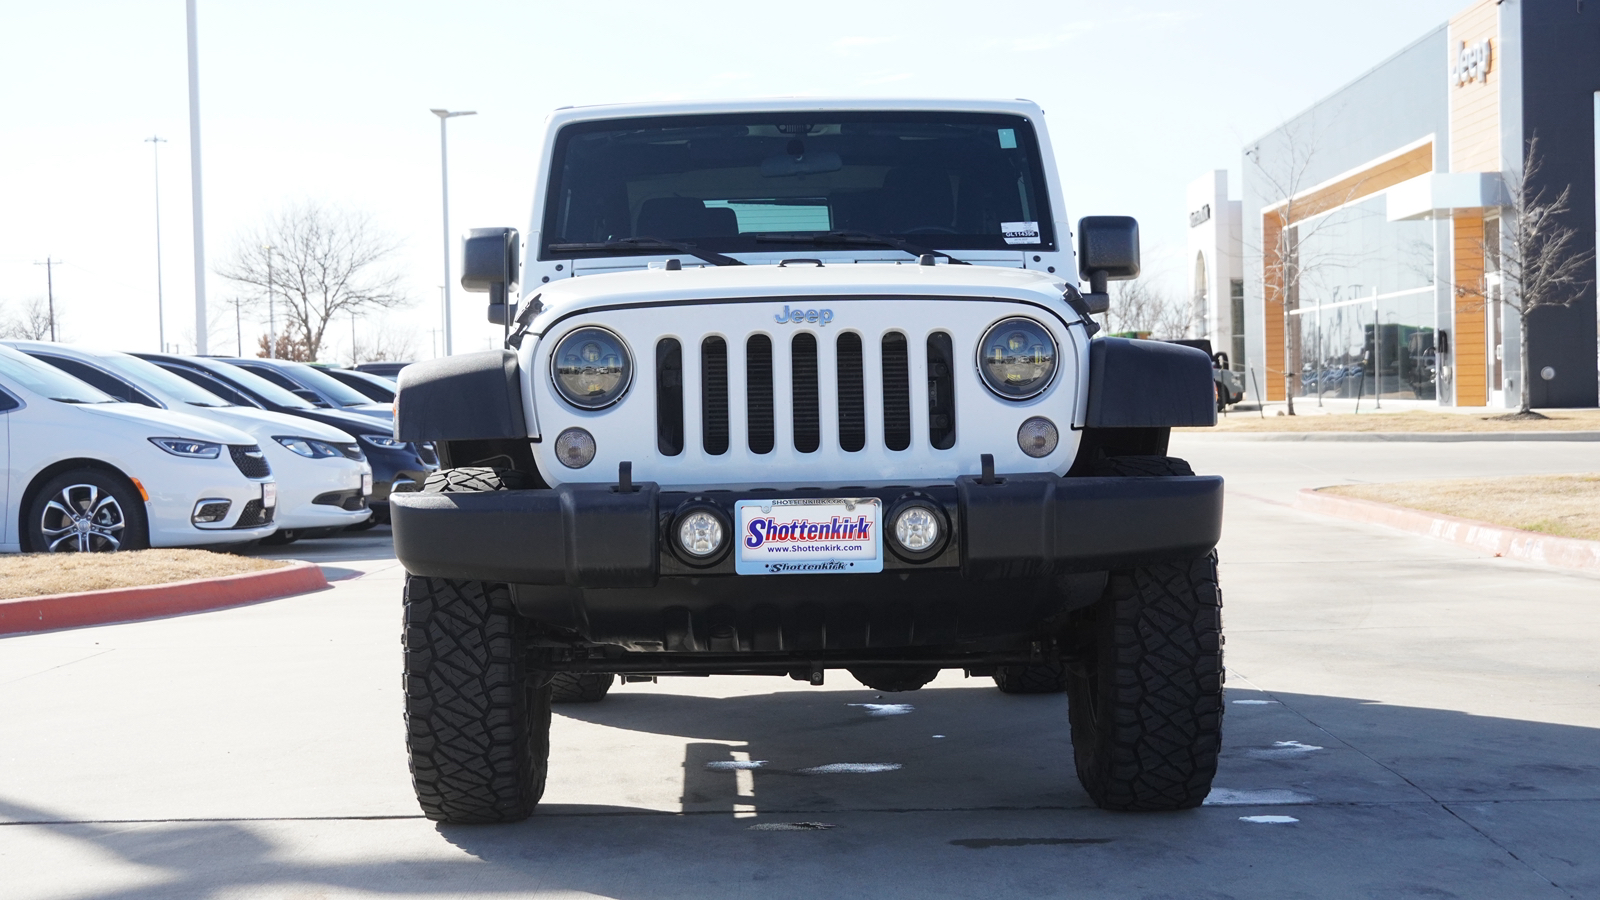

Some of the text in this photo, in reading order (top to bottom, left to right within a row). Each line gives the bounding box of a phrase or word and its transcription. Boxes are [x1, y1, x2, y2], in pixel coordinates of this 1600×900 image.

[1452, 38, 1491, 87] Jeep
[774, 305, 834, 327] Jeep
[745, 516, 872, 549] Shottenkirk
[767, 544, 862, 553] www.Shottenkirk.com
[768, 560, 847, 573] Shottenkirk
